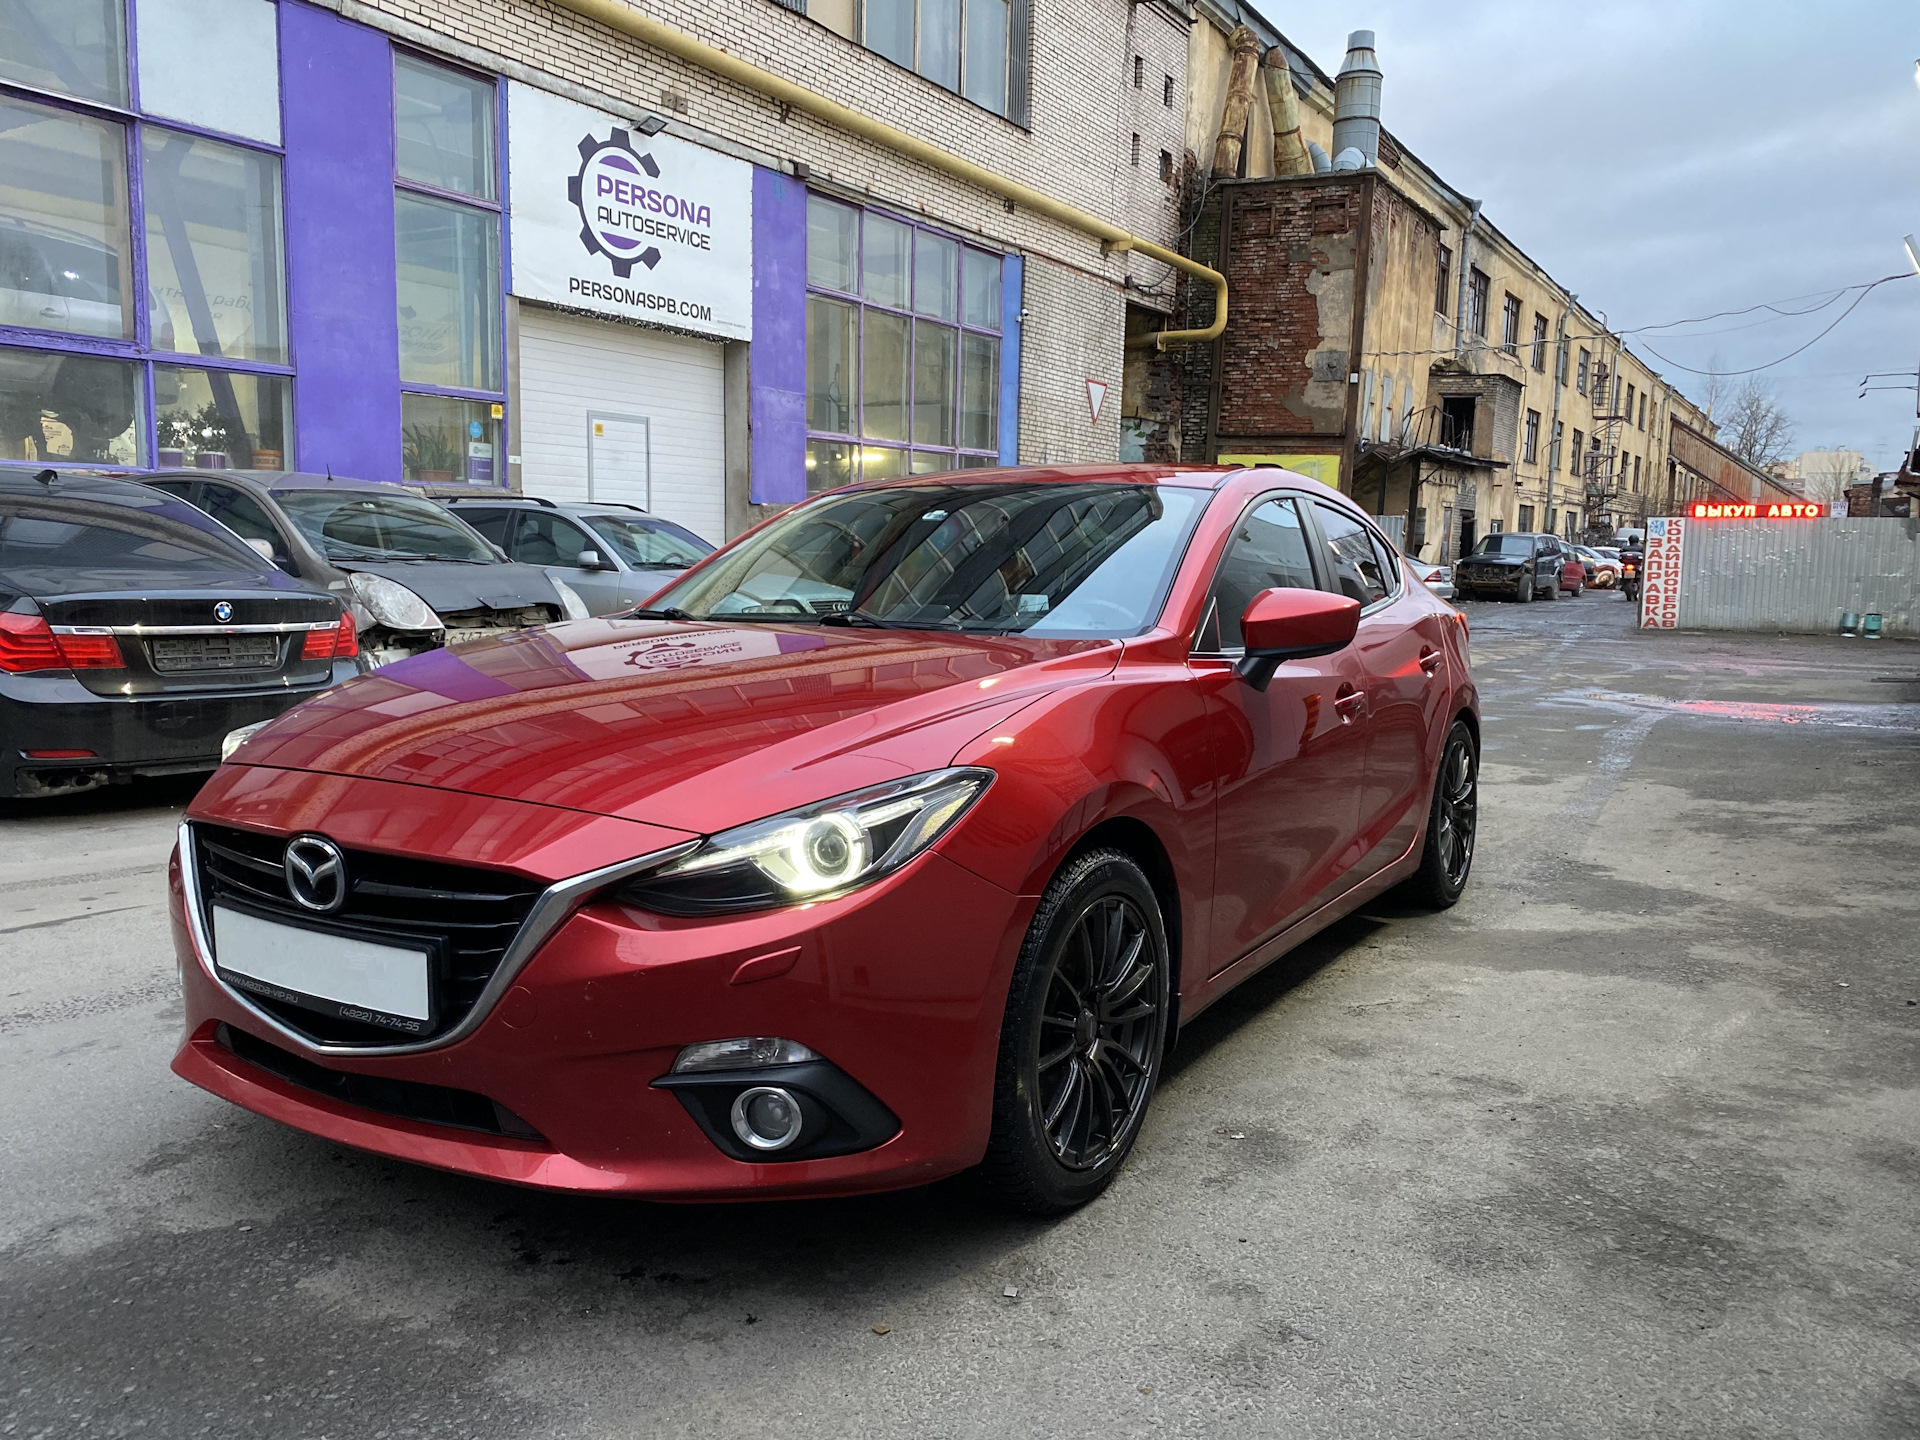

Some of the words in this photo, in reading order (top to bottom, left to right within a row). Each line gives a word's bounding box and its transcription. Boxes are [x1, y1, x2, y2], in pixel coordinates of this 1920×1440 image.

[597, 173, 711, 228] PERSONA
[597, 205, 711, 251] AUTOSERVICE
[569, 276, 712, 321] PERSONASPB.COM
[1694, 504, 1757, 517] ВЫКУП
[1767, 504, 1819, 517] АВТО
[1643, 537, 1663, 628] ЗАПРАВКА
[1661, 519, 1682, 628] КОНДИЦИОНЕРОВ
[339, 1006, 373, 1022] (4822)
[374, 1014, 421, 1032] 74-74-55
